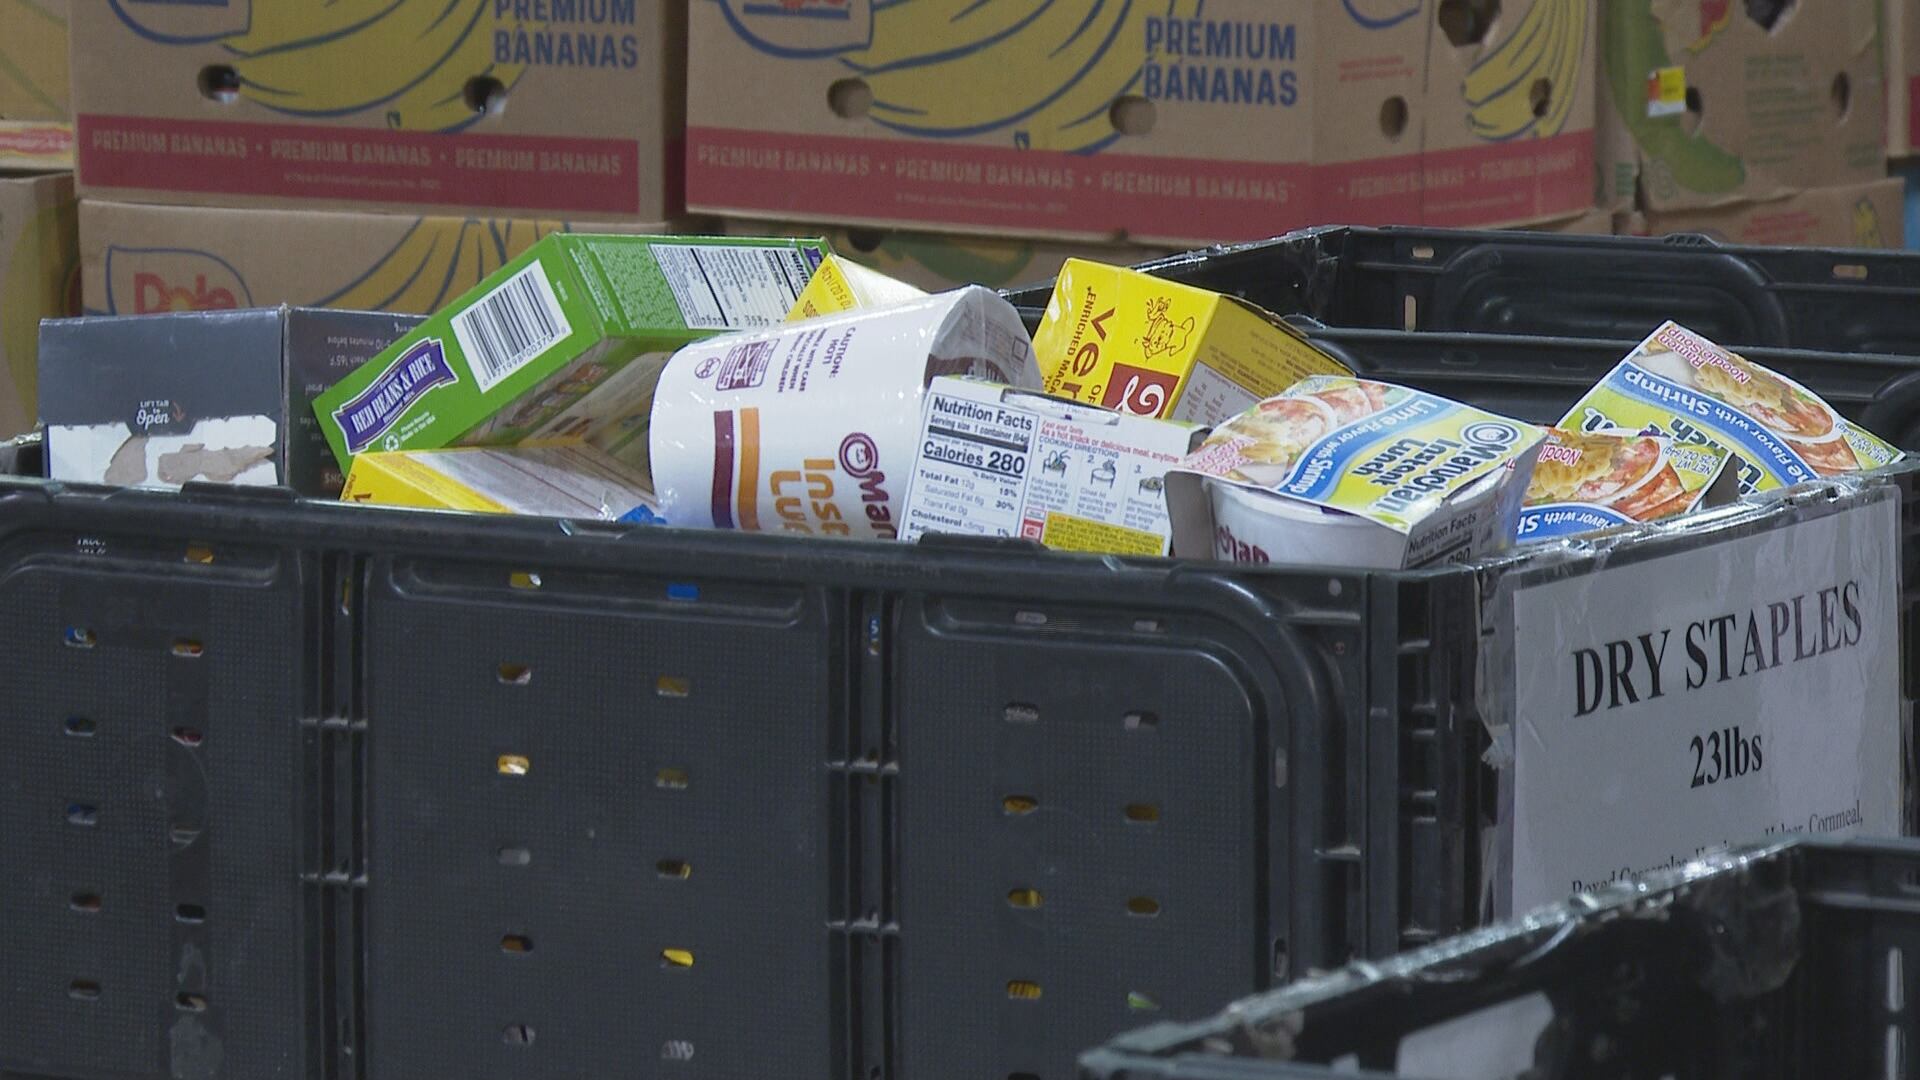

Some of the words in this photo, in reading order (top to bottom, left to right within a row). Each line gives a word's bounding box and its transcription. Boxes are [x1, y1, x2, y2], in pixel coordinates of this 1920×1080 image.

[495, 29, 638, 69] BANANAS
[1145, 17, 1297, 61] PREMIUM
[1144, 62, 1298, 107] BANANAS
[92, 130, 165, 154] PREMIUM
[171, 133, 247, 160] BANANAS
[271, 138, 348, 162] PREMIUM
[353, 142, 432, 167] BANANAS
[455, 147, 534, 171] PREMIUM
[540, 152, 621, 175] BANANAS
[698, 144, 780, 170] PREMIUM
[785, 151, 870, 177] BANANAS
[895, 158, 982, 184] PREMIUM
[986, 164, 1074, 190] BANANAS
[1102, 170, 1192, 197] PREMIUM
[1196, 177, 1289, 204] BANANAS
[134, 272, 237, 314] Dole
[828, 327, 856, 378] CAUTION:
[1658, 333, 1706, 369] Ramen
[1666, 327, 1704, 358] Soup
[1703, 350, 1751, 384] Noodle
[350, 405, 377, 434] RED
[370, 377, 404, 419] BEANS
[400, 370, 413, 391] &
[407, 352, 436, 384] RICE
[1623, 369, 1712, 417] Shrimp
[136, 409, 170, 430] Open
[930, 415, 955, 430] Serving
[932, 396, 993, 422] Nutrition
[995, 409, 1032, 431] Facts
[1381, 398, 1438, 427] Lime
[1714, 405, 1750, 433] with
[1338, 421, 1381, 444] Flavor
[1750, 426, 1794, 466] Flavor
[923, 440, 983, 466] Calories
[987, 450, 1025, 474] 280
[1288, 456, 1334, 495] Shrimp
[1352, 438, 1428, 476] Lunch
[1371, 438, 1463, 487] Instant
[1675, 459, 1691, 470] WT
[1692, 463, 1713, 475] NET
[1699, 454, 1719, 466] 2.25
[920, 469, 942, 481] Total
[945, 475, 959, 485] Fat
[1374, 443, 1508, 514] Maruchan
[911, 509, 962, 527] Cholesterol
[1408, 522, 1449, 554] Nutrition
[1450, 510, 1477, 536] Facts
[1543, 510, 1577, 527] with
[1571, 629, 1671, 718] DRY
[1685, 579, 1863, 692] STAPLES
[1689, 726, 1763, 789] 23lbs
